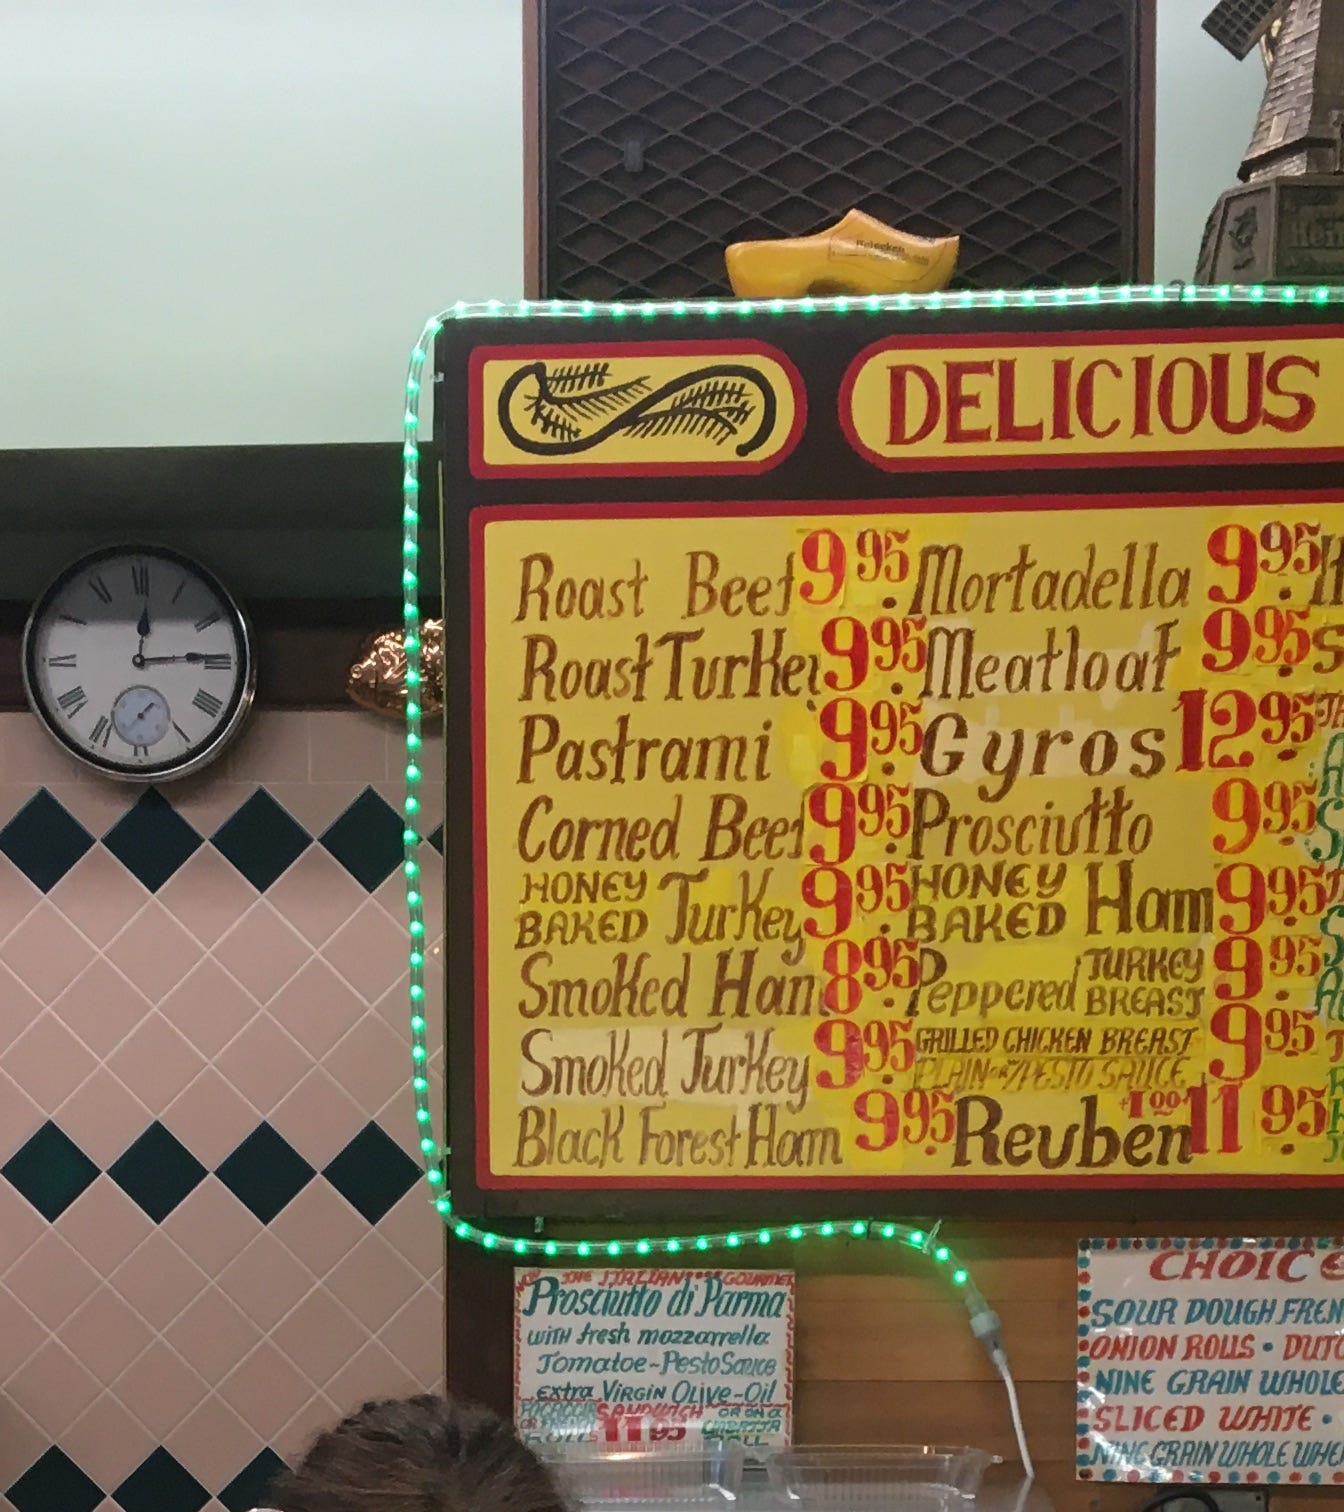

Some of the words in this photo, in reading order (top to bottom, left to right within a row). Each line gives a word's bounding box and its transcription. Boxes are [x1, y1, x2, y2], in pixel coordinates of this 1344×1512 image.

[885, 350, 1320, 446] DELICIOUS
[511, 551, 649, 622] Roast
[909, 541, 1193, 616] Mortadella
[517, 632, 654, 702] Roast
[918, 618, 1183, 702] Meatloaf
[516, 712, 774, 785] Pastrami
[919, 712, 1169, 803] Gyros
[517, 793, 684, 863] Corned
[910, 786, 1154, 861] Prosciutto
[513, 906, 650, 951] BAKED
[656, 866, 809, 966] Turkey
[522, 869, 649, 904] HONEY
[906, 899, 1069, 946] BAKED
[1082, 857, 1216, 938] Ham
[911, 862, 1068, 903] HONEY
[517, 948, 692, 1020] Smoked
[1083, 946, 1207, 984] TURKEY
[1084, 984, 1208, 1022] BREAST
[519, 1026, 671, 1098] Smoked
[679, 1021, 812, 1115] Turkey
[914, 1026, 1000, 1056] GRILLED
[1001, 1024, 1094, 1057] CHICKEN
[1097, 1024, 1202, 1058] BREAST
[512, 1104, 626, 1170] Black
[638, 1099, 741, 1169] Forest
[742, 1100, 846, 1171] Ham
[950, 1094, 1198, 1169] Reuben
[522, 1276, 663, 1318] Prosciutto
[694, 1275, 789, 1318] Parma
[1092, 1297, 1178, 1329] SOUR
[1186, 1297, 1277, 1327] DOUGH
[575, 1320, 632, 1346] fresh
[1089, 1333, 1179, 1362] ONION
[1182, 1333, 1257, 1362] ROLLS
[1166, 1368, 1255, 1397] GRAIN
[1092, 1404, 1206, 1433] SLICED
[1216, 1404, 1317, 1433] WHITE
[1148, 1440, 1219, 1467] GRAIN
